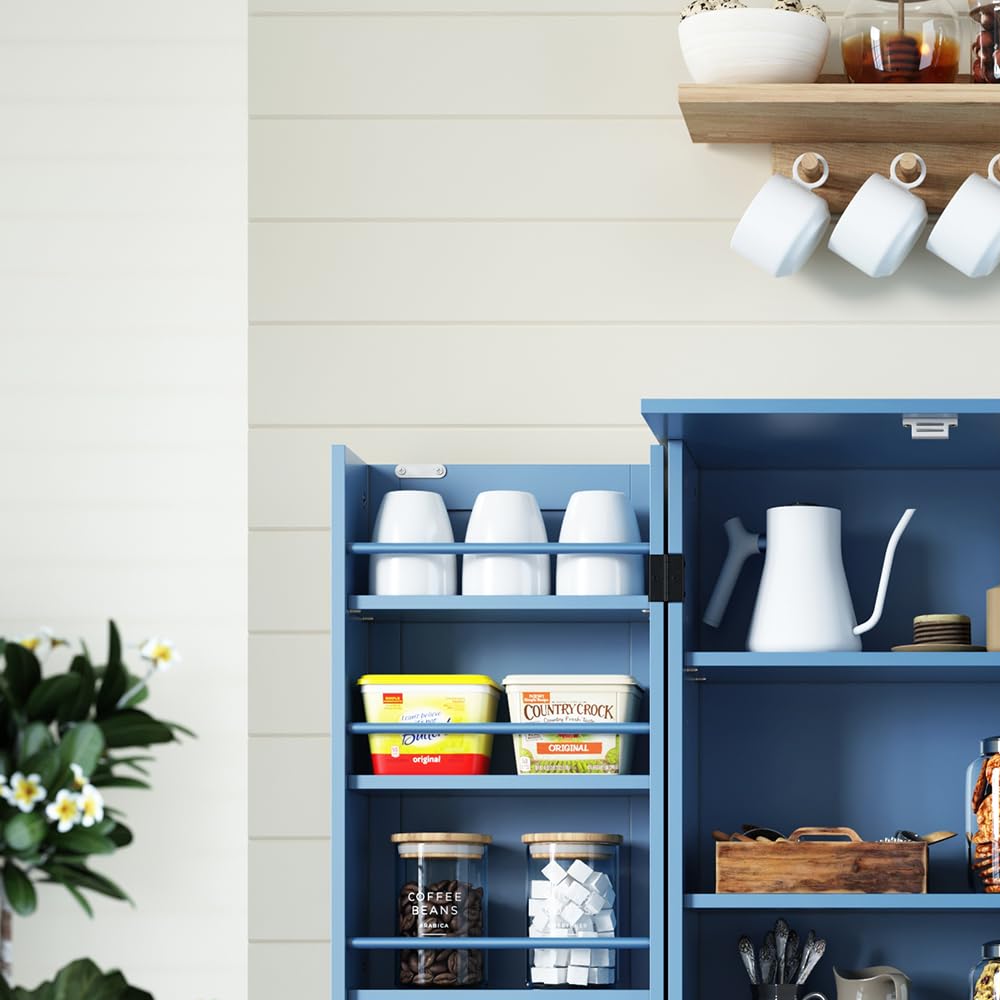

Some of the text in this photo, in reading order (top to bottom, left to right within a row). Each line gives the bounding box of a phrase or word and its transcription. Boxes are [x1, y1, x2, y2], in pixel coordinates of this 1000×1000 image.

[524, 703, 614, 720] COUNTRY CROCK
[548, 744, 589, 752] ORIGINAL
[412, 755, 441, 765] original
[407, 891, 462, 902] COFFEE
[411, 905, 459, 916] BEANS
